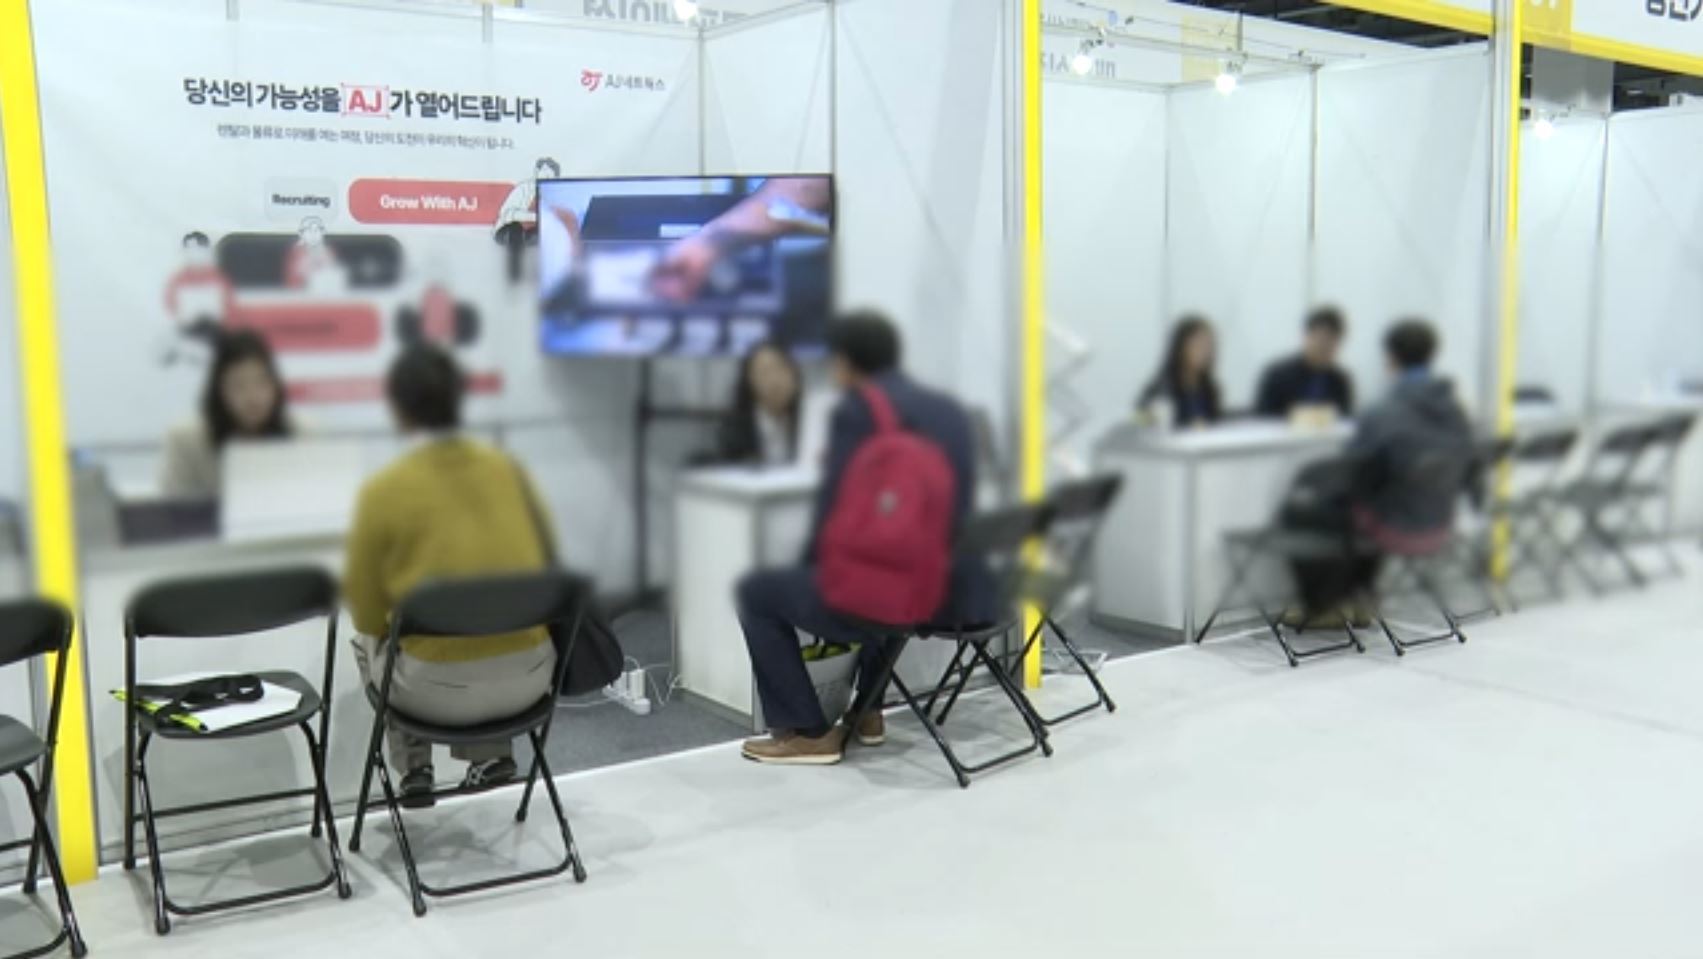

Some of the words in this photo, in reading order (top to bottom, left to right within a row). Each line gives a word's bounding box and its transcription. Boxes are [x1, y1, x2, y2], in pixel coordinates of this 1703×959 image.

[183, 78, 253, 108] 당신의
[256, 83, 341, 113] 가능성을
[349, 89, 383, 114] AJ
[390, 89, 412, 118] 가
[416, 91, 542, 124] 열어드립니다
[285, 127, 316, 141] 미래를
[365, 131, 394, 145] 당신의
[428, 134, 456, 147] 우리의
[272, 193, 330, 209] Recruiting
[380, 194, 420, 210] Grow
[422, 194, 456, 210] With
[458, 195, 478, 211] AJ
